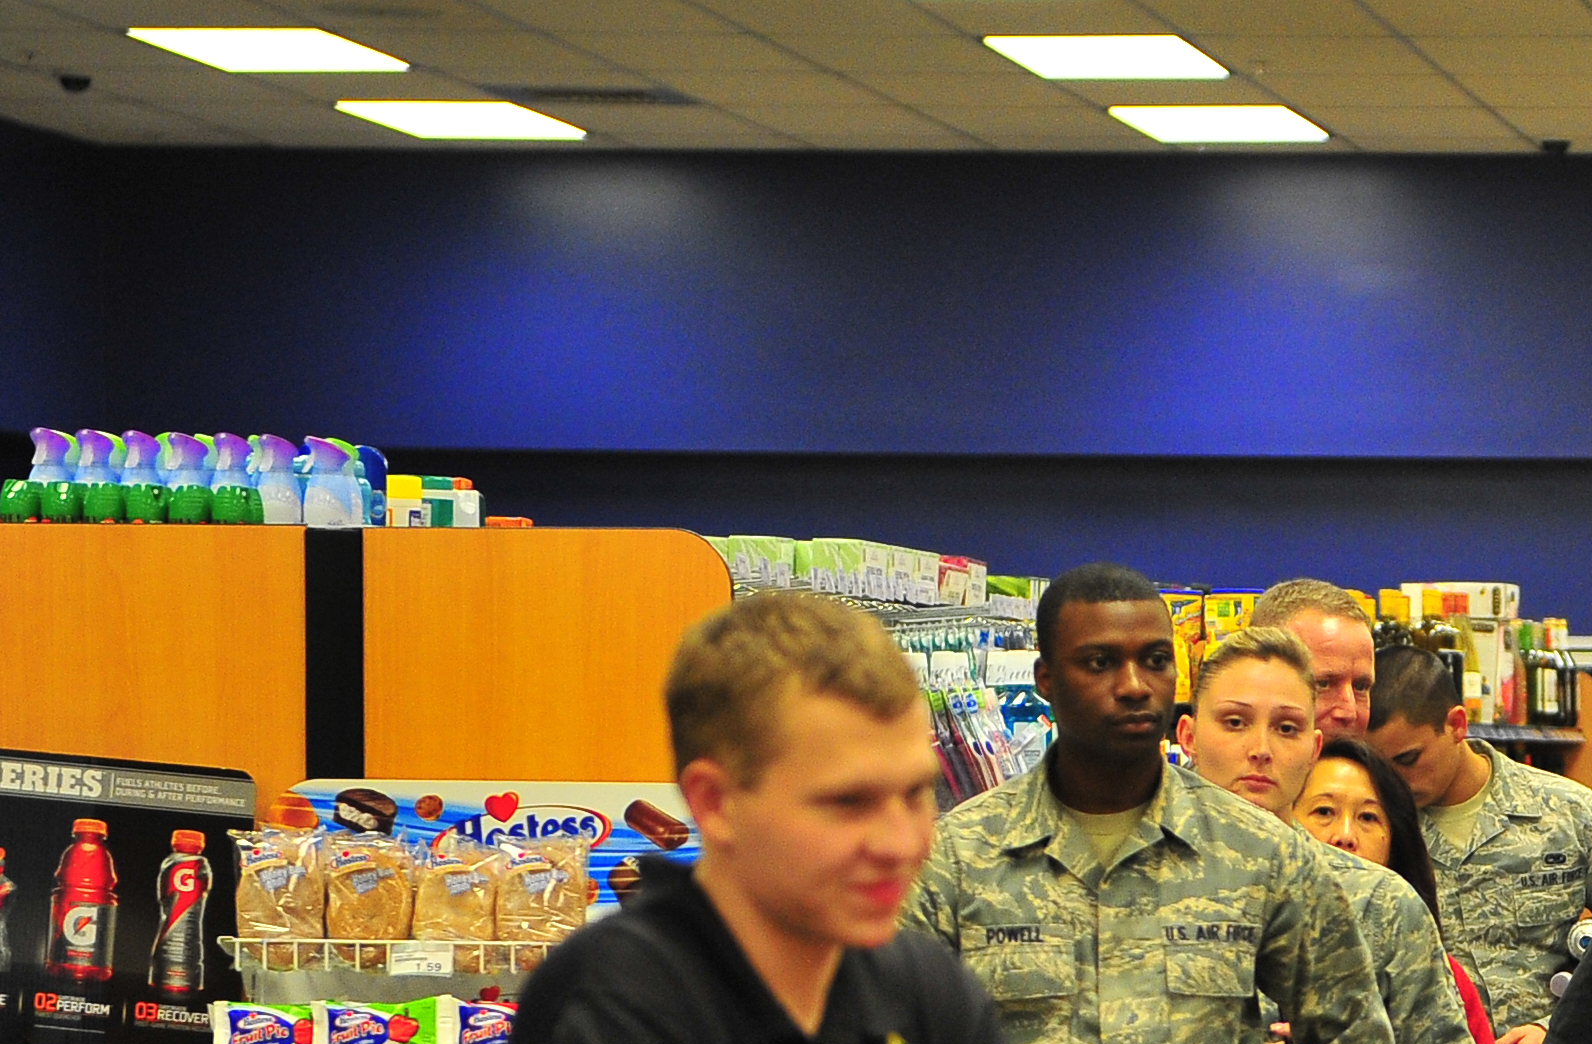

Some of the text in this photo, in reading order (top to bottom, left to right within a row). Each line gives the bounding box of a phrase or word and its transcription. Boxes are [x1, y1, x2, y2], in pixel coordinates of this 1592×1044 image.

[116, 777, 143, 788] FUELS
[144, 780, 184, 792] ATHLETES
[116, 789, 246, 807] DURING & AFTER PERFORMANCE
[456, 812, 597, 847] Hostess
[174, 868, 196, 892] G
[1521, 875, 1538, 887] U.S.
[1541, 873, 1558, 886] AIR
[63, 907, 98, 945] G
[986, 925, 1044, 944] POWELL
[1165, 926, 1187, 942] U.S.
[1196, 926, 1219, 942] AIR
[34, 992, 58, 1012] 02
[57, 1000, 110, 1016] PERFORM
[134, 1001, 209, 1024] 03 RECOVER
[264, 1022, 290, 1040] Pie
[360, 1021, 386, 1040] Pie
[491, 1021, 511, 1038] Pi
